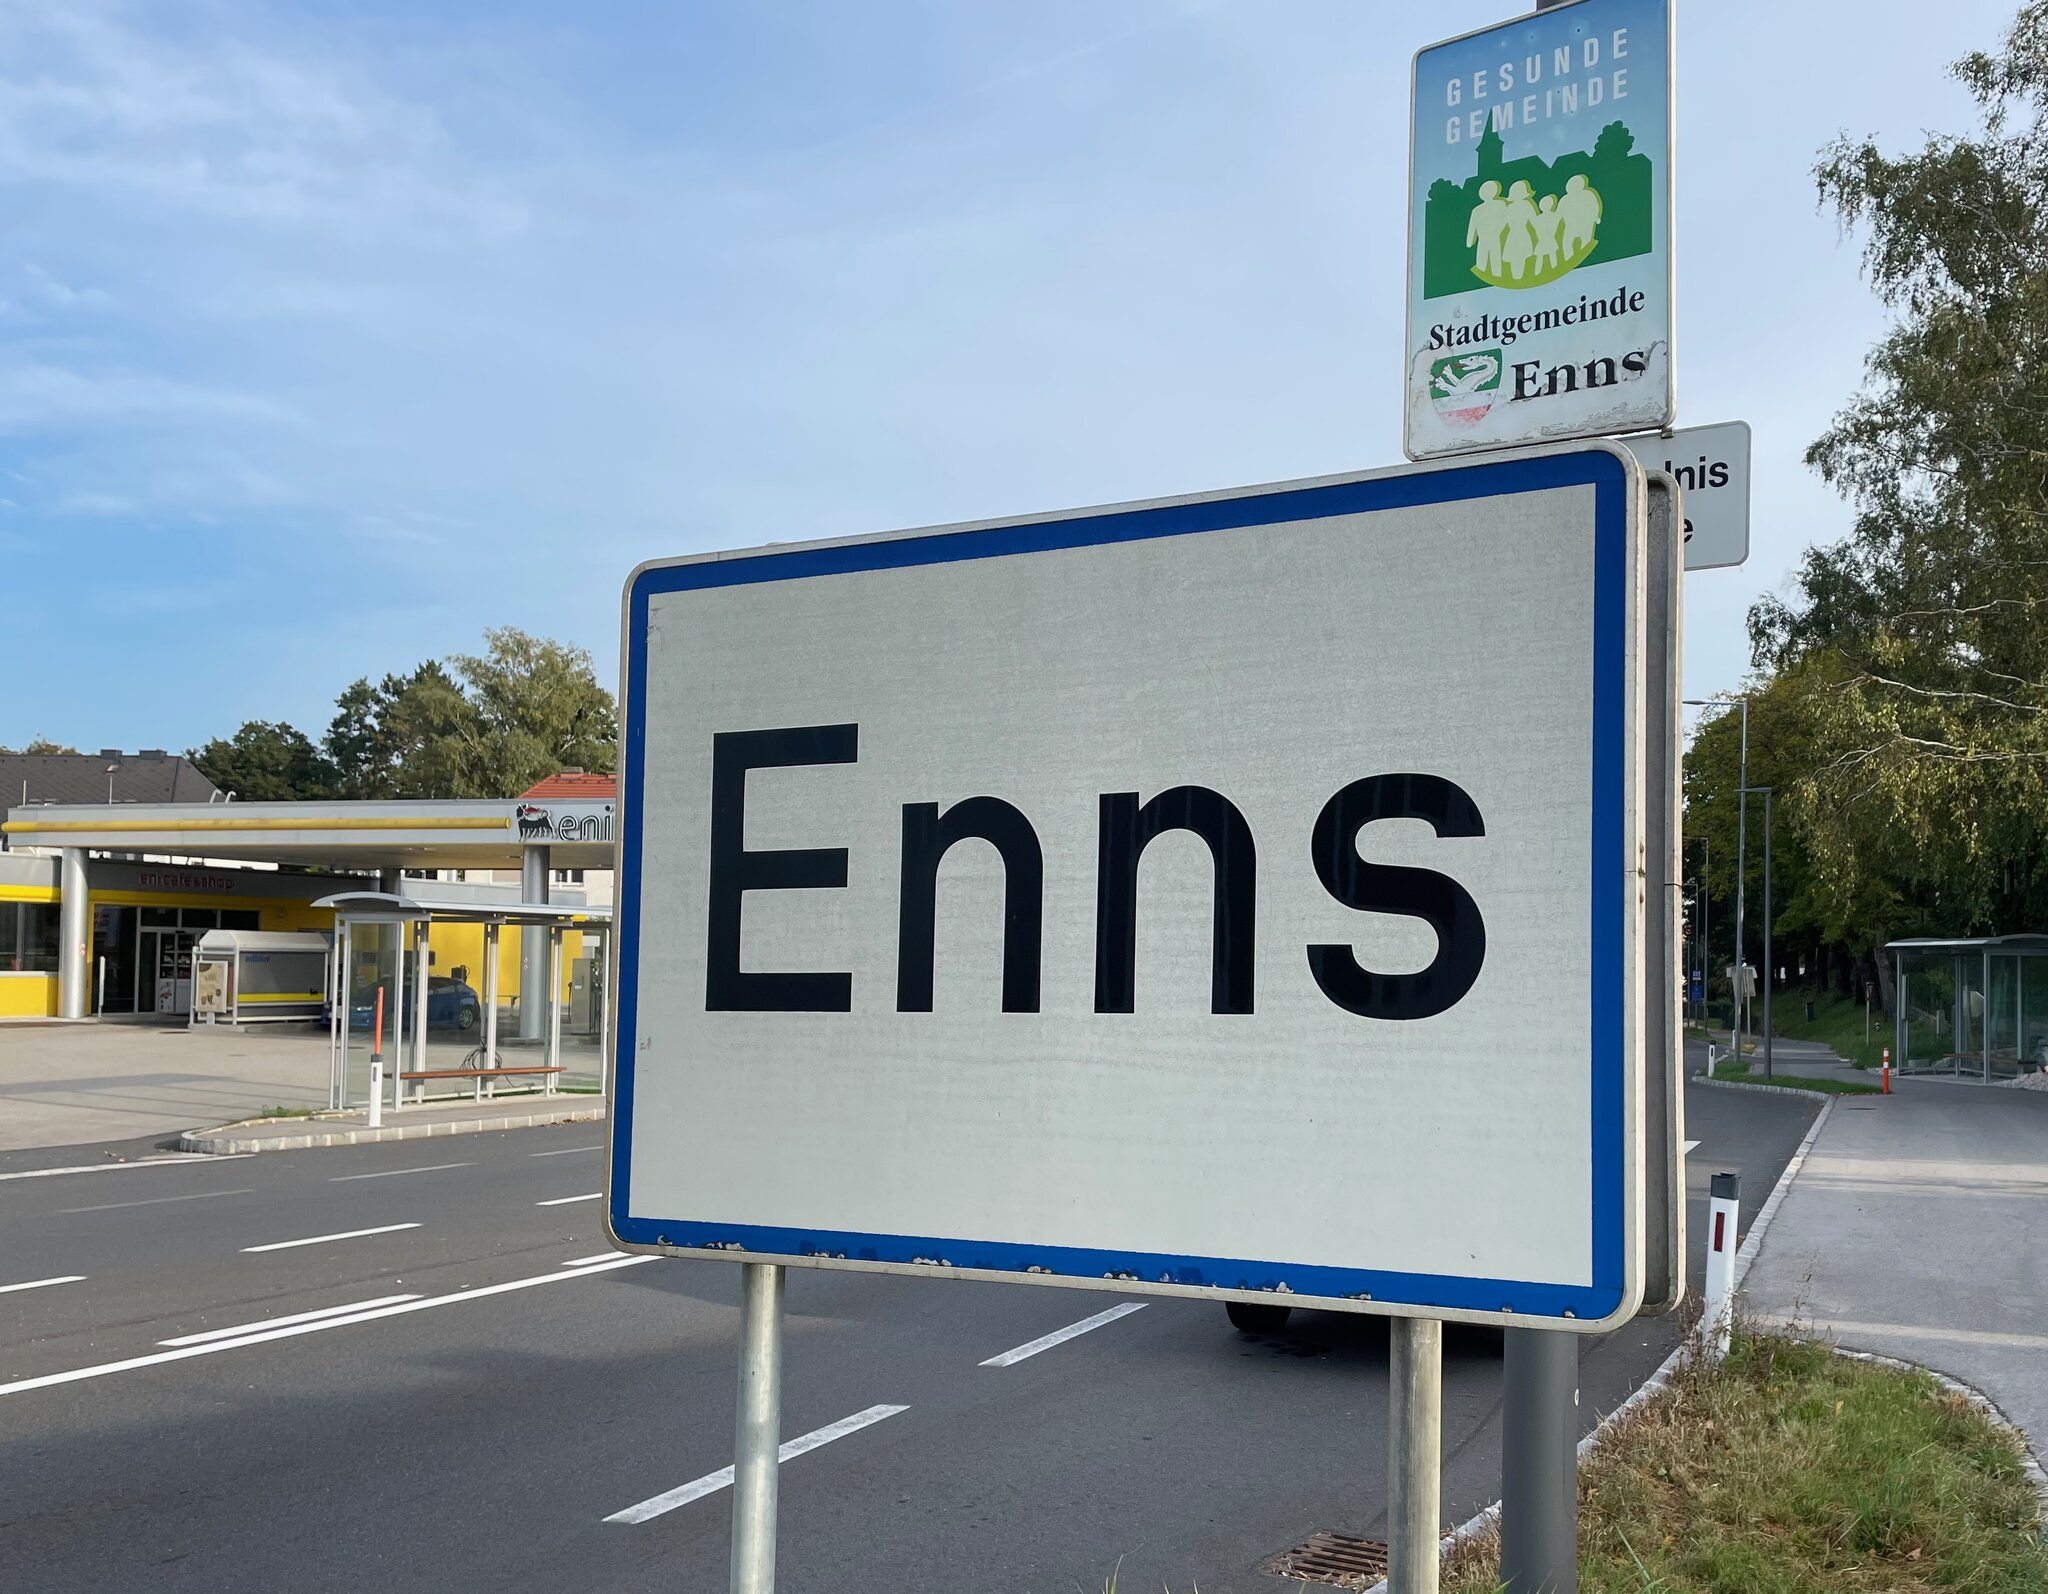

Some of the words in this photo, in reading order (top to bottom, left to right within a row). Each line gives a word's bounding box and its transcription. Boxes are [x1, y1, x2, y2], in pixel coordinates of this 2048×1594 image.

[1446, 27, 1628, 106] GESUNDE
[1446, 68, 1628, 144] GEMEINDE
[1429, 286, 1645, 350] Stadtgemeinde
[1510, 350, 1645, 402] Enns
[558, 804, 613, 840] eni
[705, 722, 1487, 1021] Enns
